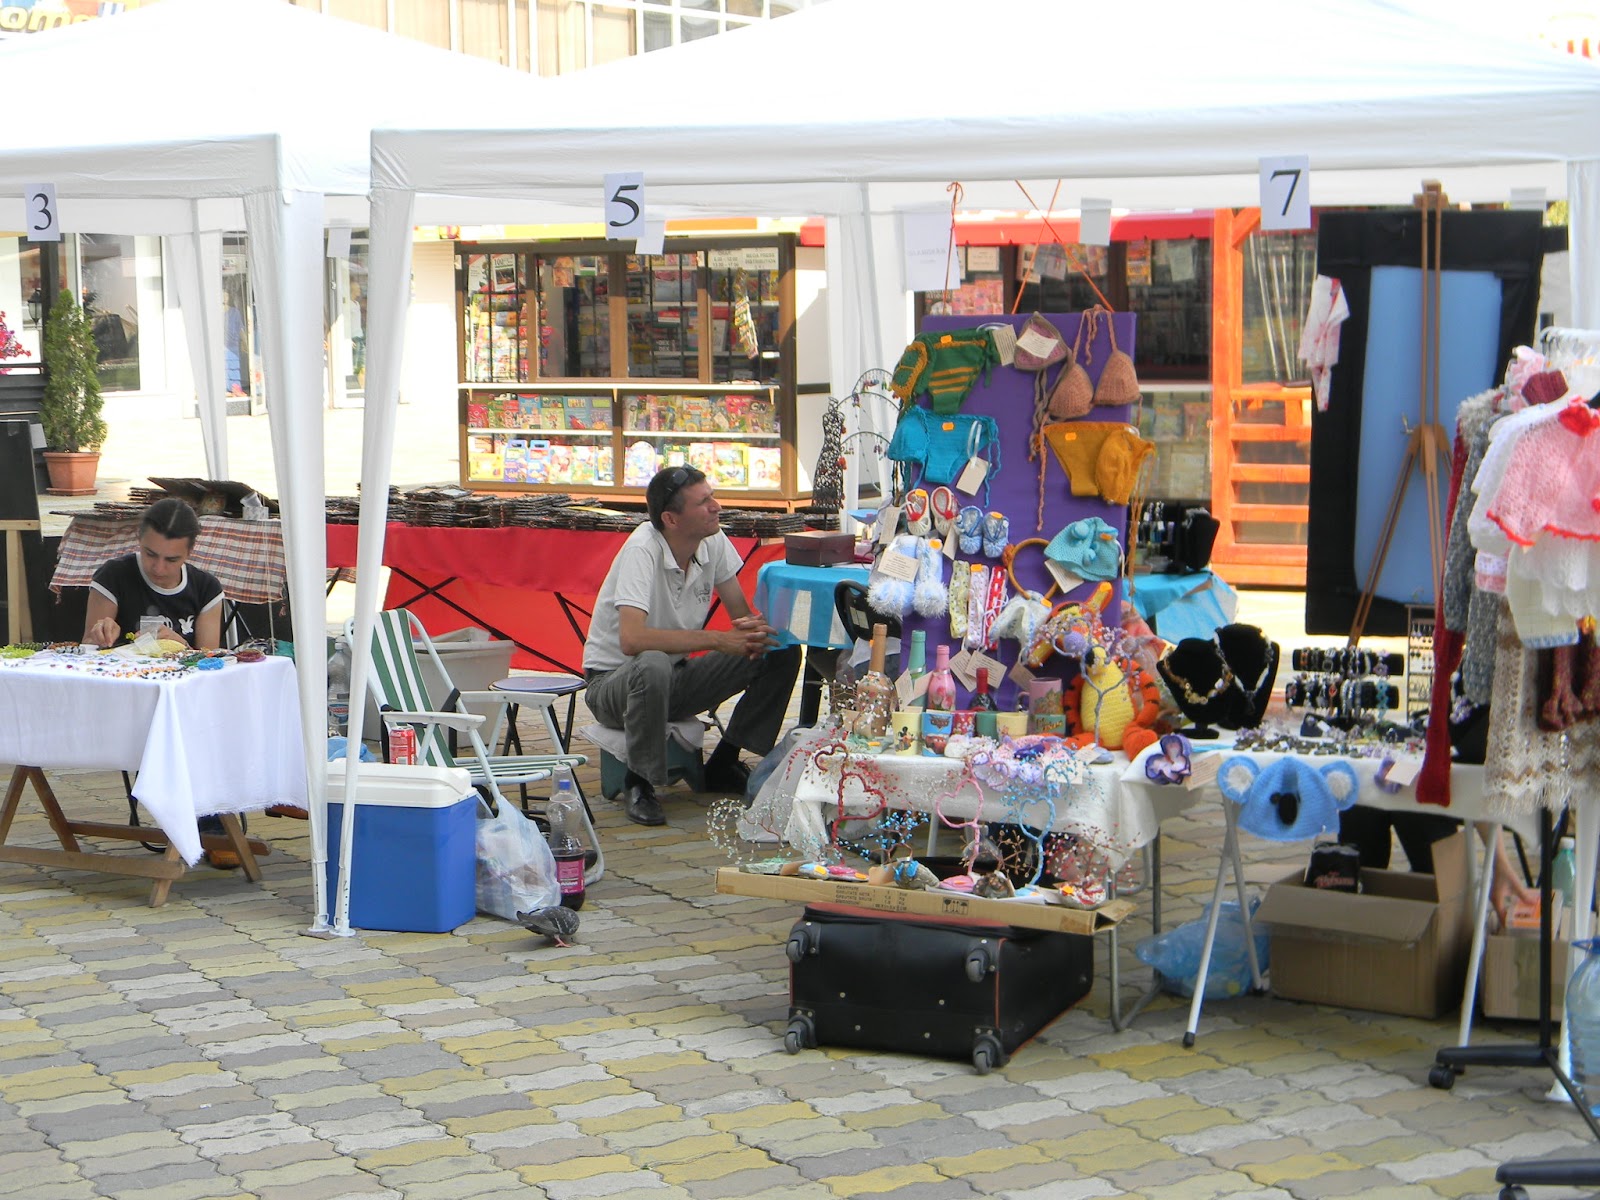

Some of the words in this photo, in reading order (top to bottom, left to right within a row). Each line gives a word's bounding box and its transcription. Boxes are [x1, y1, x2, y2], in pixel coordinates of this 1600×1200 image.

[32, 192, 52, 231] 3
[609, 184, 640, 227] 5
[1271, 169, 1300, 217] 7
